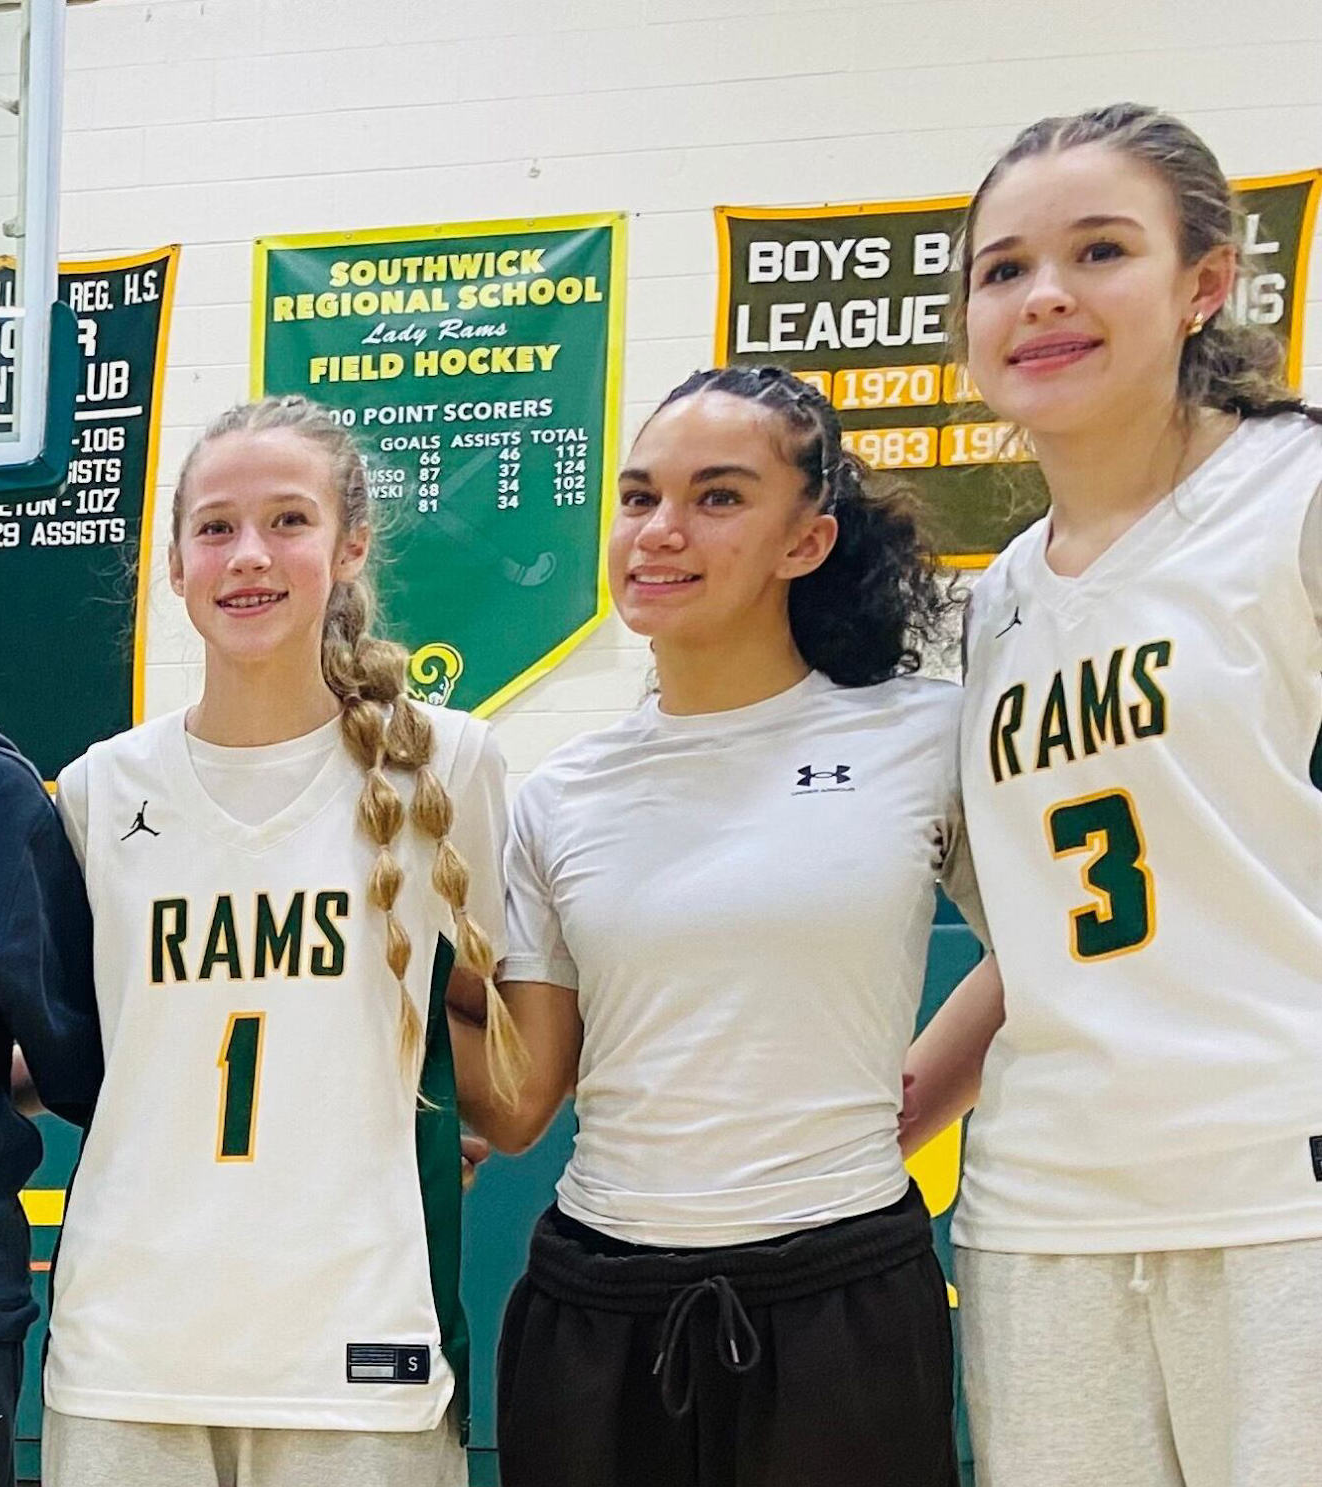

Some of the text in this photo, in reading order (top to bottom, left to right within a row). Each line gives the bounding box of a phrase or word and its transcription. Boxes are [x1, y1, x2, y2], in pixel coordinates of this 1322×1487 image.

[328, 249, 547, 288] SOUTHWICK
[748, 236, 892, 284] BOYS
[69, 280, 115, 313] REG.
[124, 269, 160, 306] H.S.
[273, 276, 604, 323] REGIONAL SCHOOL
[361, 317, 509, 347] Lady Rams
[736, 293, 951, 354] LEAGUE
[309, 343, 563, 385] FIELD HOCKEY
[841, 368, 935, 408] 1970
[363, 404, 439, 426] POINT
[443, 398, 553, 422] SCORERS
[380, 428, 589, 452] GOALS ASSISTS TOTAL
[419, 451, 441, 466] 66
[498, 448, 521, 462] 46
[555, 444, 588, 459] 112
[417, 483, 440, 498] 68
[497, 479, 520, 494] 34
[553, 476, 586, 492] 102
[418, 467, 441, 482] 87
[498, 464, 520, 478] 37
[553, 460, 587, 475] 124
[417, 491, 586, 513] 81 34 115
[30, 516, 127, 547] ASSISTS
[987, 636, 1175, 785] RAMS
[1042, 786, 1158, 964] 3
[147, 888, 352, 986] RAMS
[214, 1010, 267, 1163] 1
[407, 1356, 419, 1372] S
